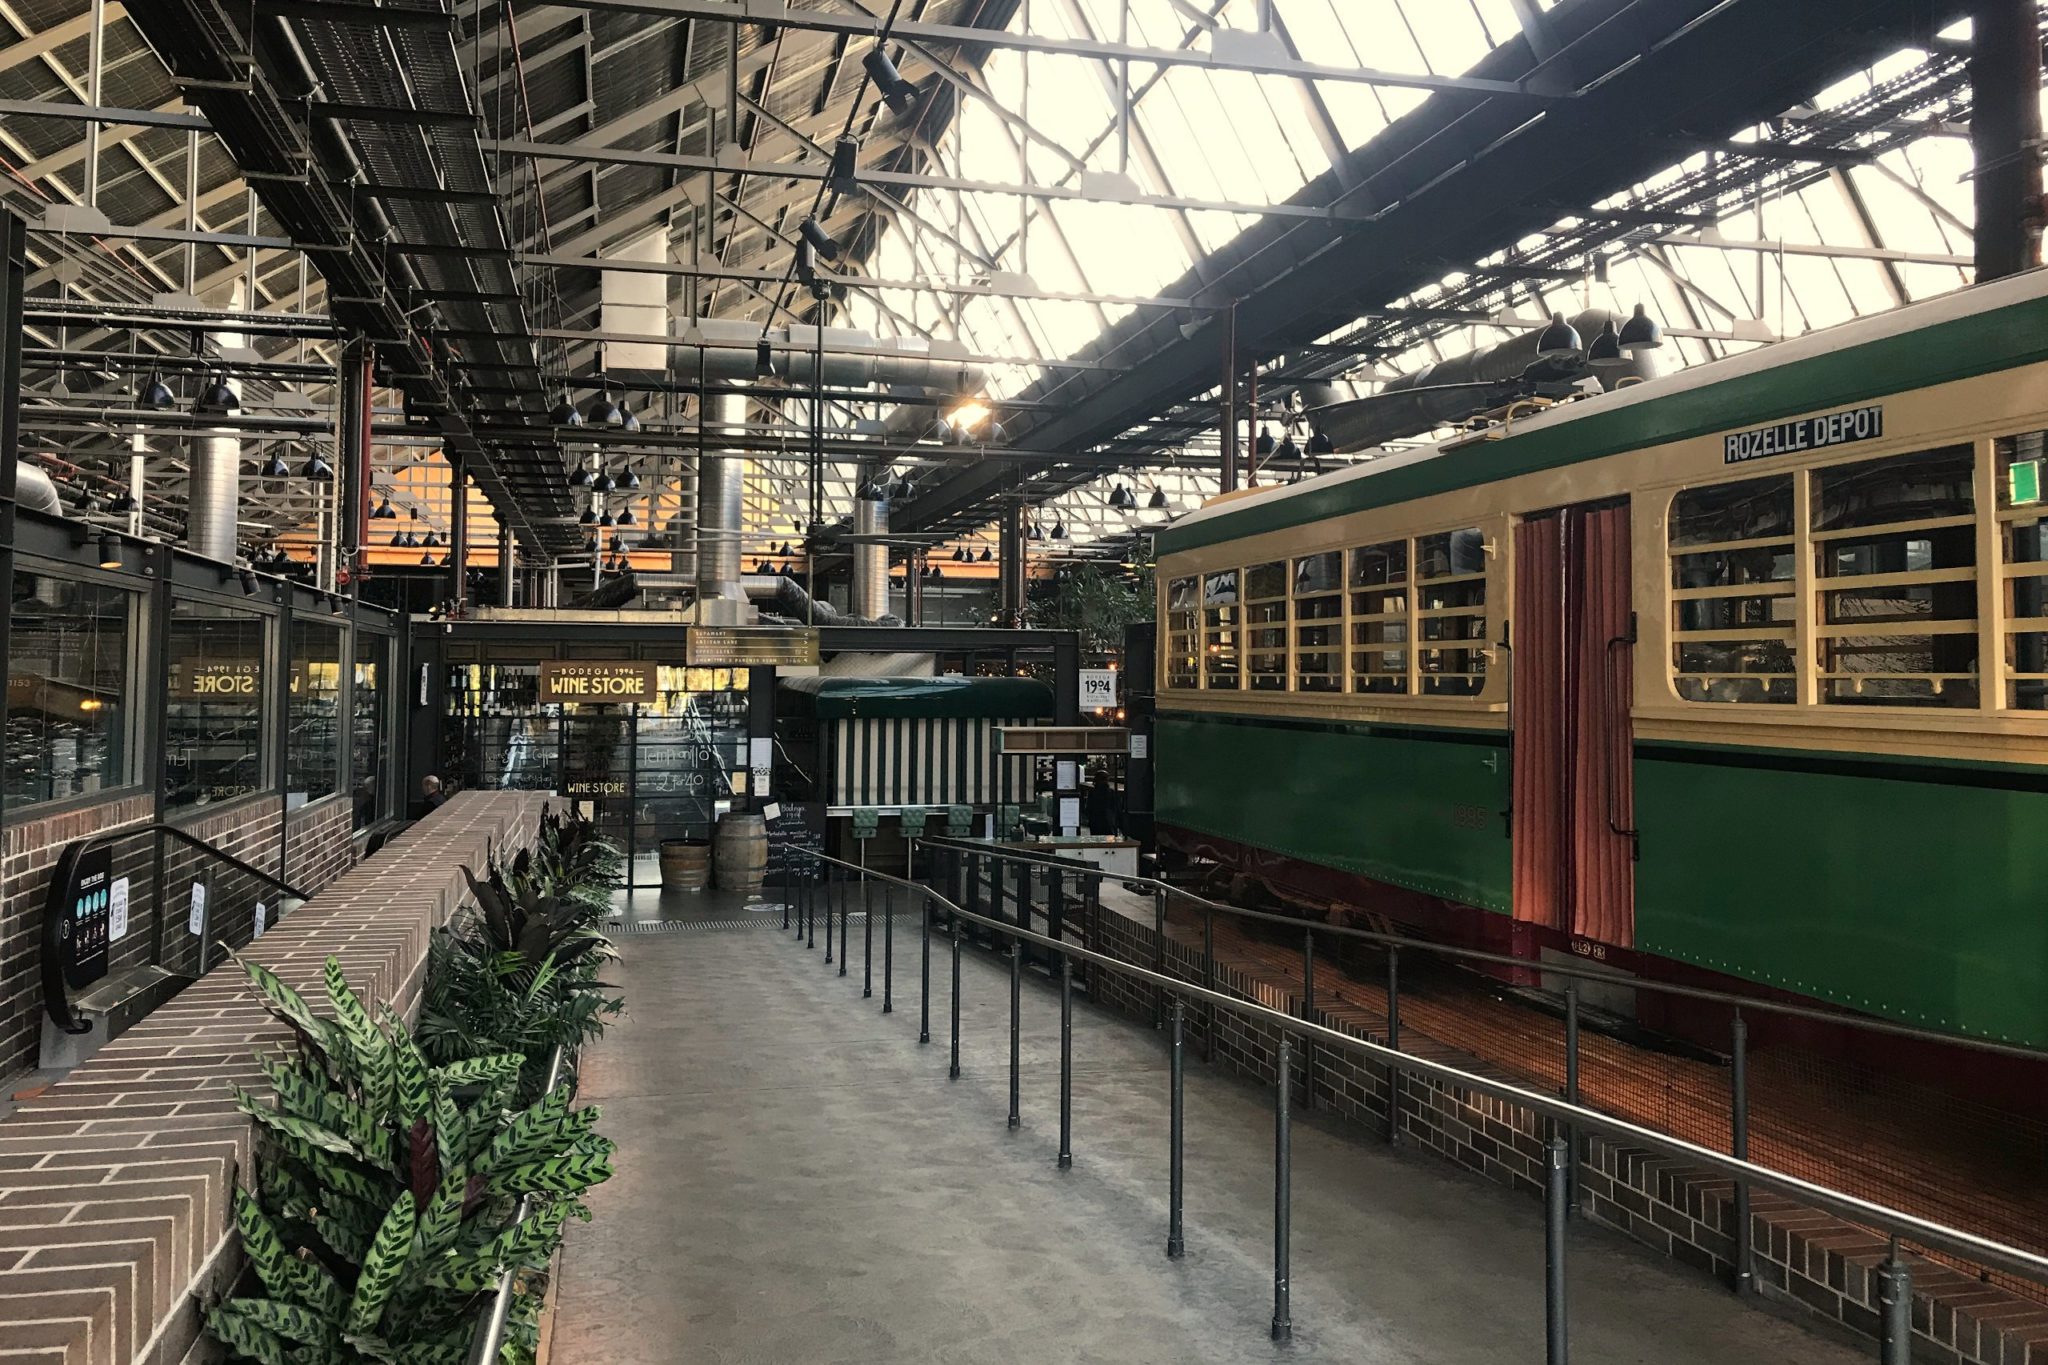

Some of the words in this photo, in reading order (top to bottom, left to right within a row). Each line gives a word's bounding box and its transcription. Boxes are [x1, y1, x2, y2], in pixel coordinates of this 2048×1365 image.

[1727, 420, 1808, 462] ROZELLE
[1813, 406, 1883, 446] DEPOT
[550, 677, 589, 694] WINE
[591, 677, 645, 694] STORE
[567, 782, 591, 793] WINE
[592, 782, 625, 793] STORE
